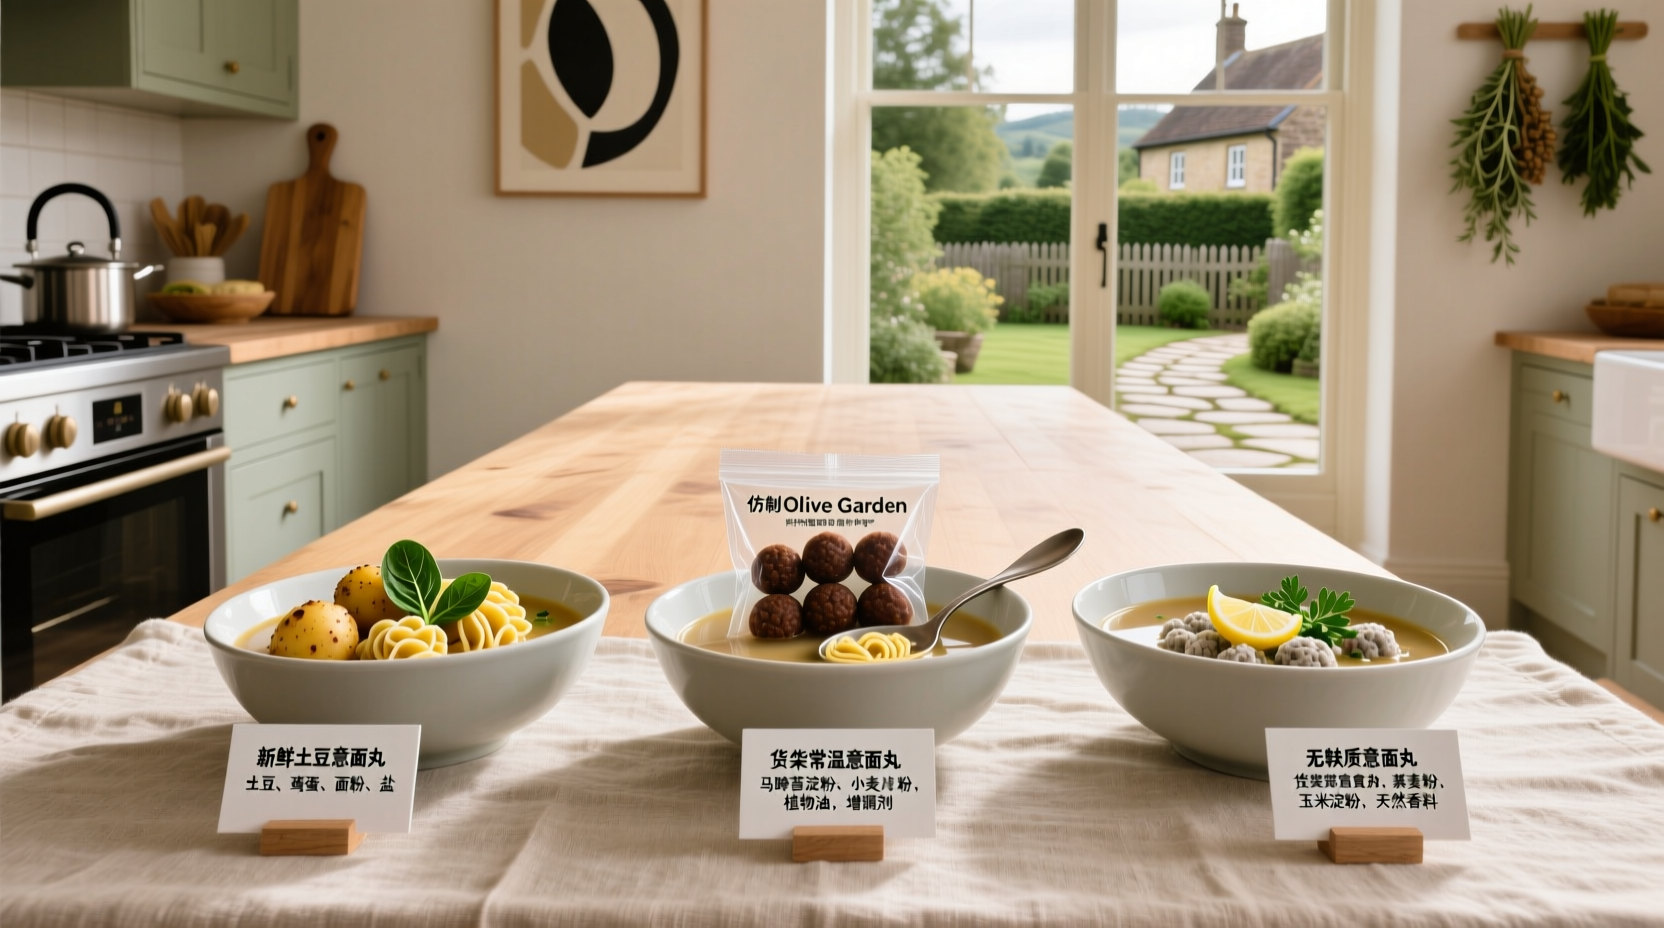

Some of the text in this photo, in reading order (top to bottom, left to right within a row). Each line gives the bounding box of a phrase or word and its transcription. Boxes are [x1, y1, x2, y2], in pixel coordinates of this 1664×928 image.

[837, 496, 907, 514] Garden
[256, 745, 386, 768] 新鲜土豆意面丸
